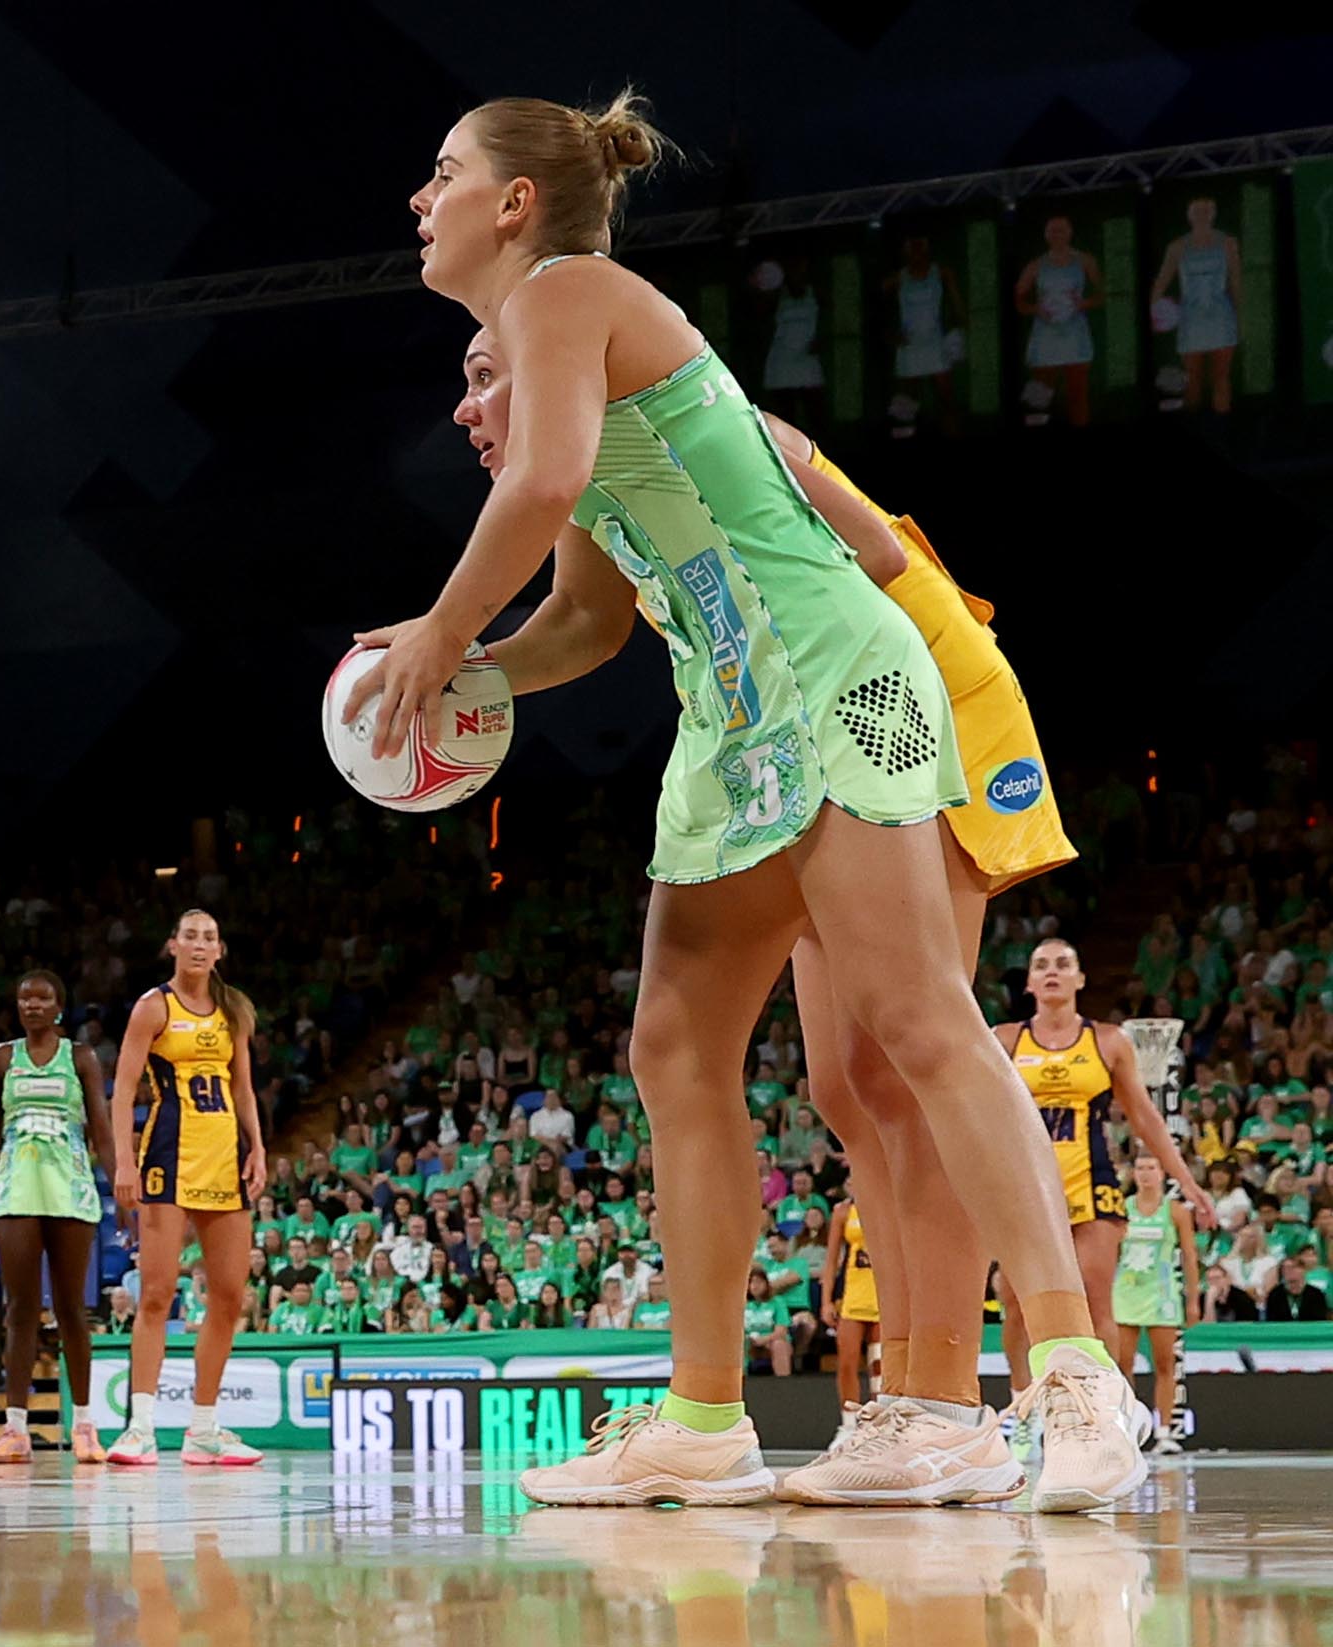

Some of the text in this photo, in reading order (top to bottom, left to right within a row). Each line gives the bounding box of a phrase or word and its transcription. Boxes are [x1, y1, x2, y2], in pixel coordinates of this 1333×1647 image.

[742, 743, 784, 826] 5
[992, 773, 1040, 800] Cetaphil
[189, 1074, 228, 1113] GA
[146, 1167, 165, 1196] 6
[156, 1384, 253, 1401] Fortcue
[333, 1387, 393, 1451] US
[406, 1387, 464, 1451] TO
[480, 1387, 587, 1451] REAL
